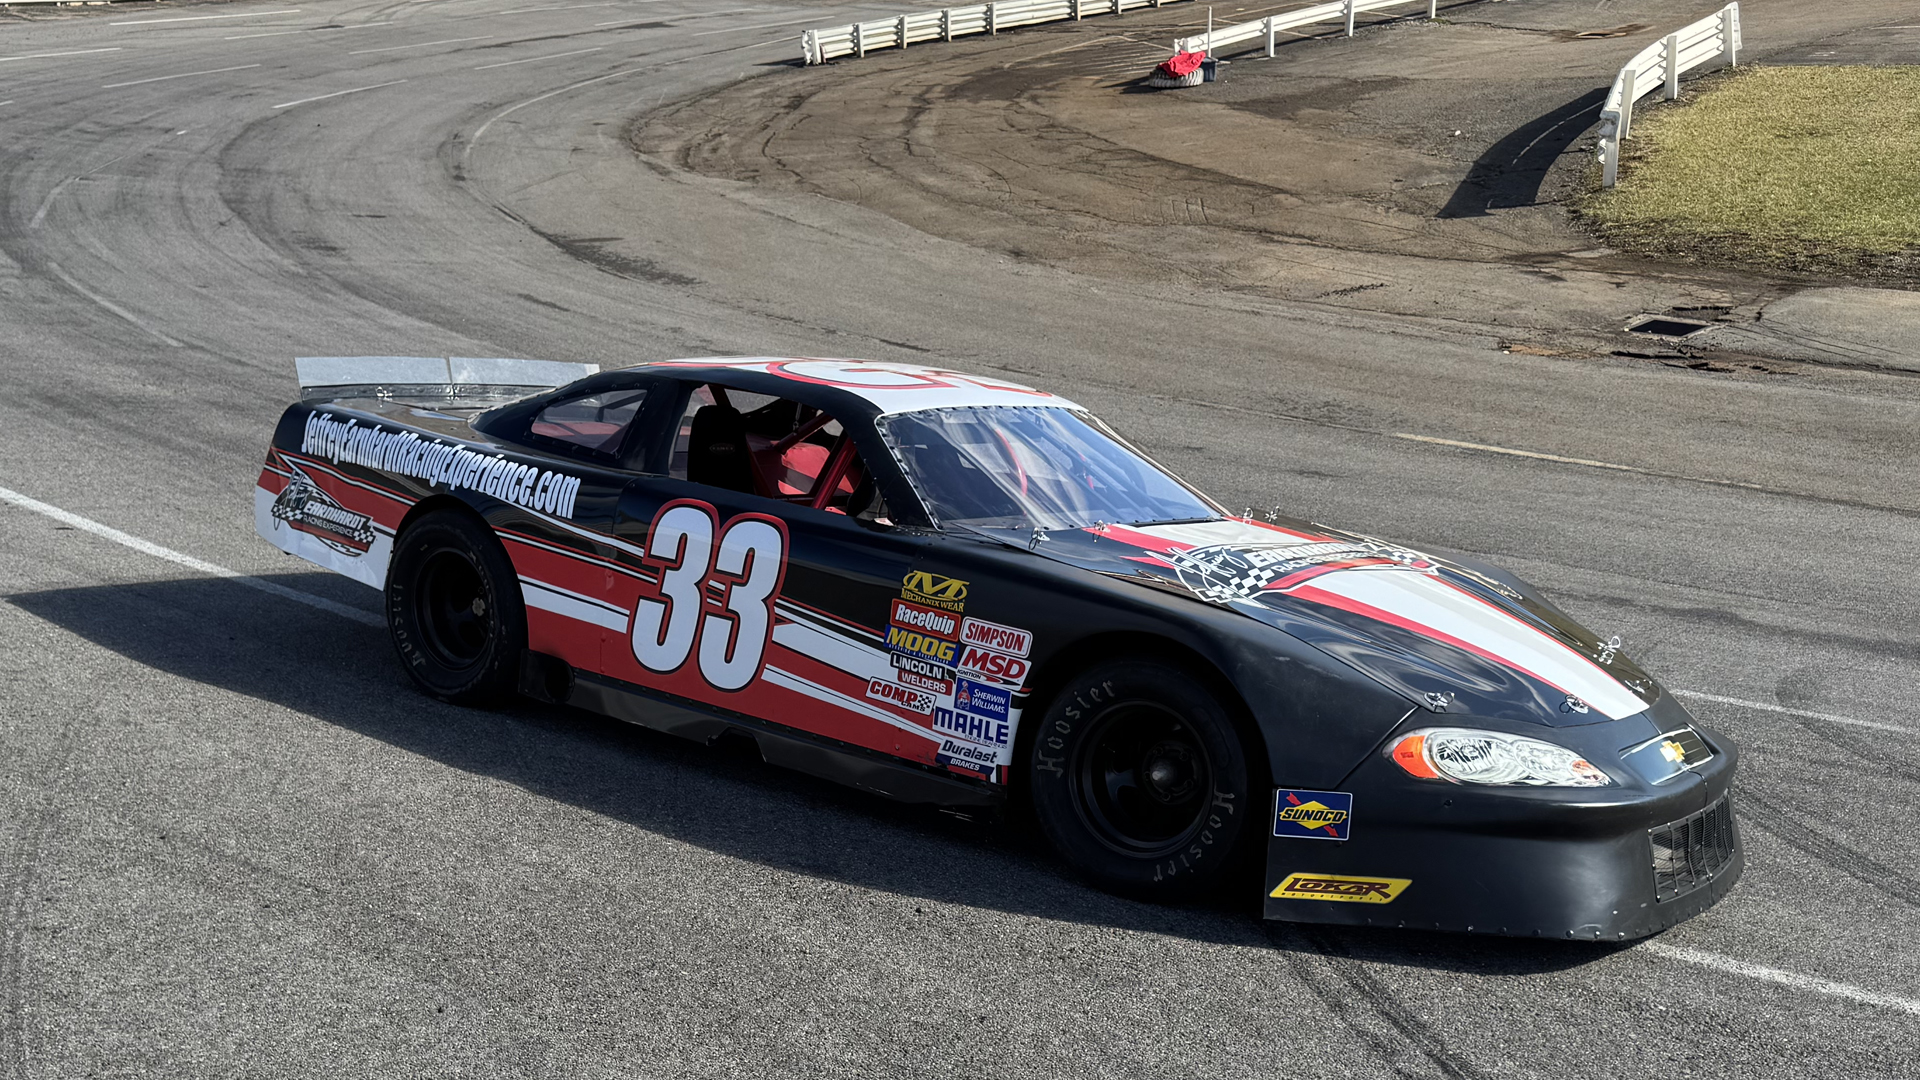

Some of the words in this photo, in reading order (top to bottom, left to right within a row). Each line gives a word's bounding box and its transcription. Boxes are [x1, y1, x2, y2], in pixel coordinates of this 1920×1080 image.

[302, 410, 581, 519] JeffreyEarnhardtRacingExperience.com
[303, 500, 367, 530] EARNHARDT
[631, 499, 789, 693] 33
[901, 587, 940, 608] MECHANIX
[940, 601, 965, 613] WEAR
[895, 603, 955, 635] RaceQuip
[886, 627, 957, 662] MOOG
[965, 622, 1027, 652] SIMPSON
[892, 654, 943, 680] LINCOLN
[957, 668, 982, 680] IGNITION
[961, 648, 1026, 680] MSD
[869, 680, 919, 704] COMP
[901, 671, 947, 693] WELDERS
[900, 699, 926, 713] CAMS
[972, 688, 1007, 705] SHERWIN
[933, 705, 1010, 745] MAHLE
[1036, 679, 1116, 780] Hoosier
[942, 739, 998, 764] Duralast
[950, 757, 980, 772] BRAKES
[1281, 807, 1346, 824] SUNOCO
[1153, 781, 1236, 883] Hoosier
[1283, 876, 1392, 900] LOKAR
